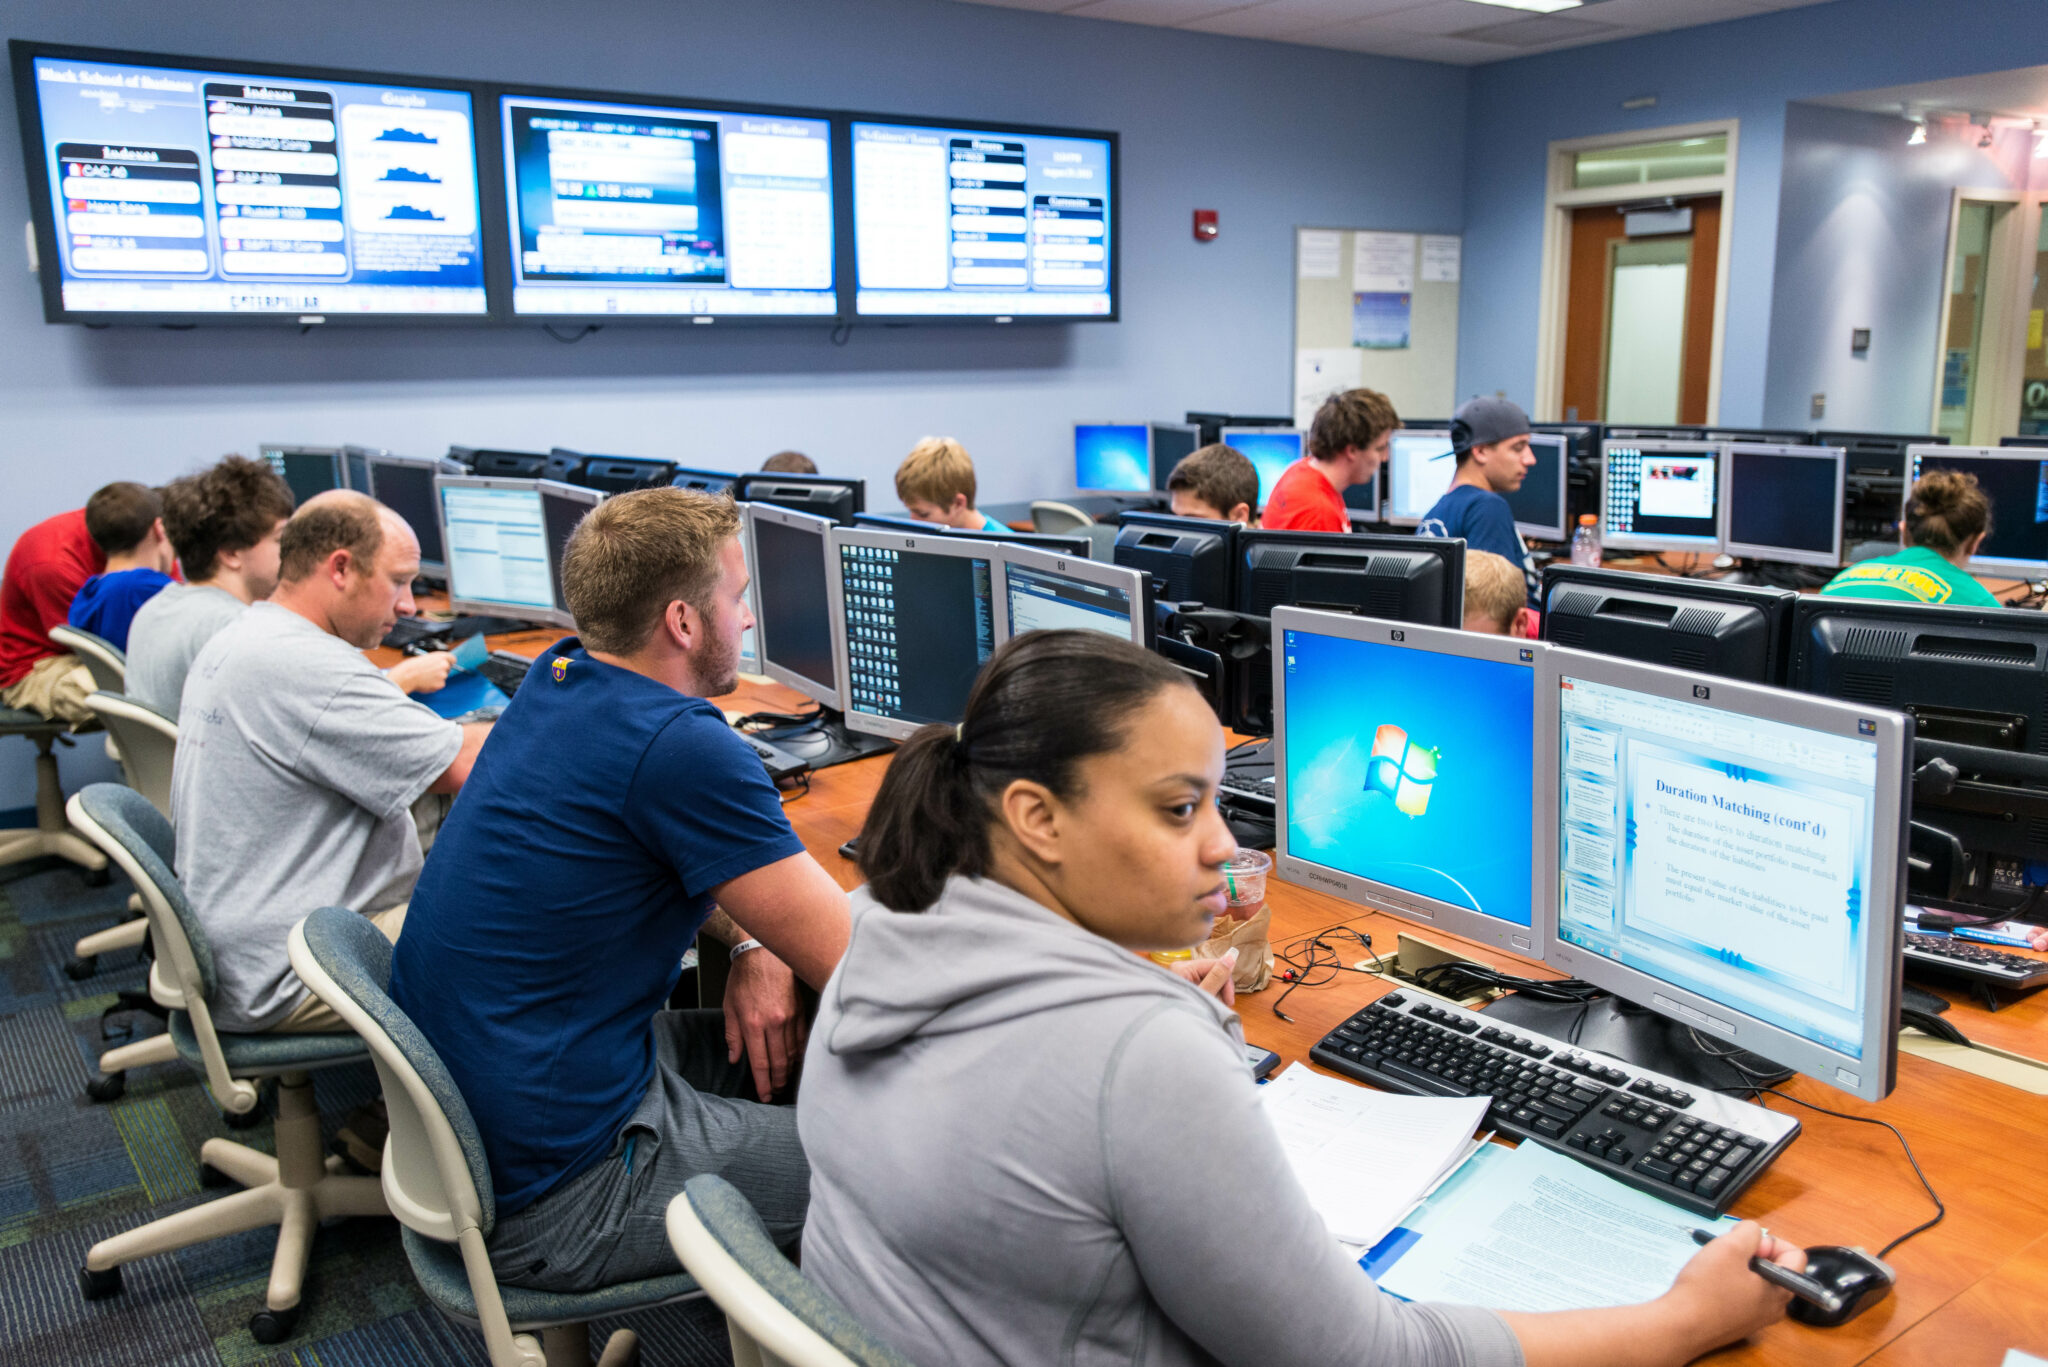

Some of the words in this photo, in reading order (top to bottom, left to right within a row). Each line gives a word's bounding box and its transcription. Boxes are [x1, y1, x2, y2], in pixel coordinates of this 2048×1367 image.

[242, 85, 296, 102] Indexes
[102, 145, 159, 161] Indexes
[82, 163, 111, 178] CAC
[1656, 779, 1707, 804] Duration
[1712, 794, 1771, 824] Matching
[1657, 803, 1681, 819] There
[1683, 814, 1696, 824] are
[1747, 830, 1783, 849] duration
[1667, 823, 1680, 834] The
[1682, 827, 1710, 842] duration
[1723, 838, 1734, 850] the
[1666, 834, 1677, 845] the
[1719, 851, 1731, 863] the
[1666, 862, 1679, 875] The
[1681, 869, 1706, 884] present
[1739, 887, 1751, 898] the
[1776, 912, 1789, 924] the
